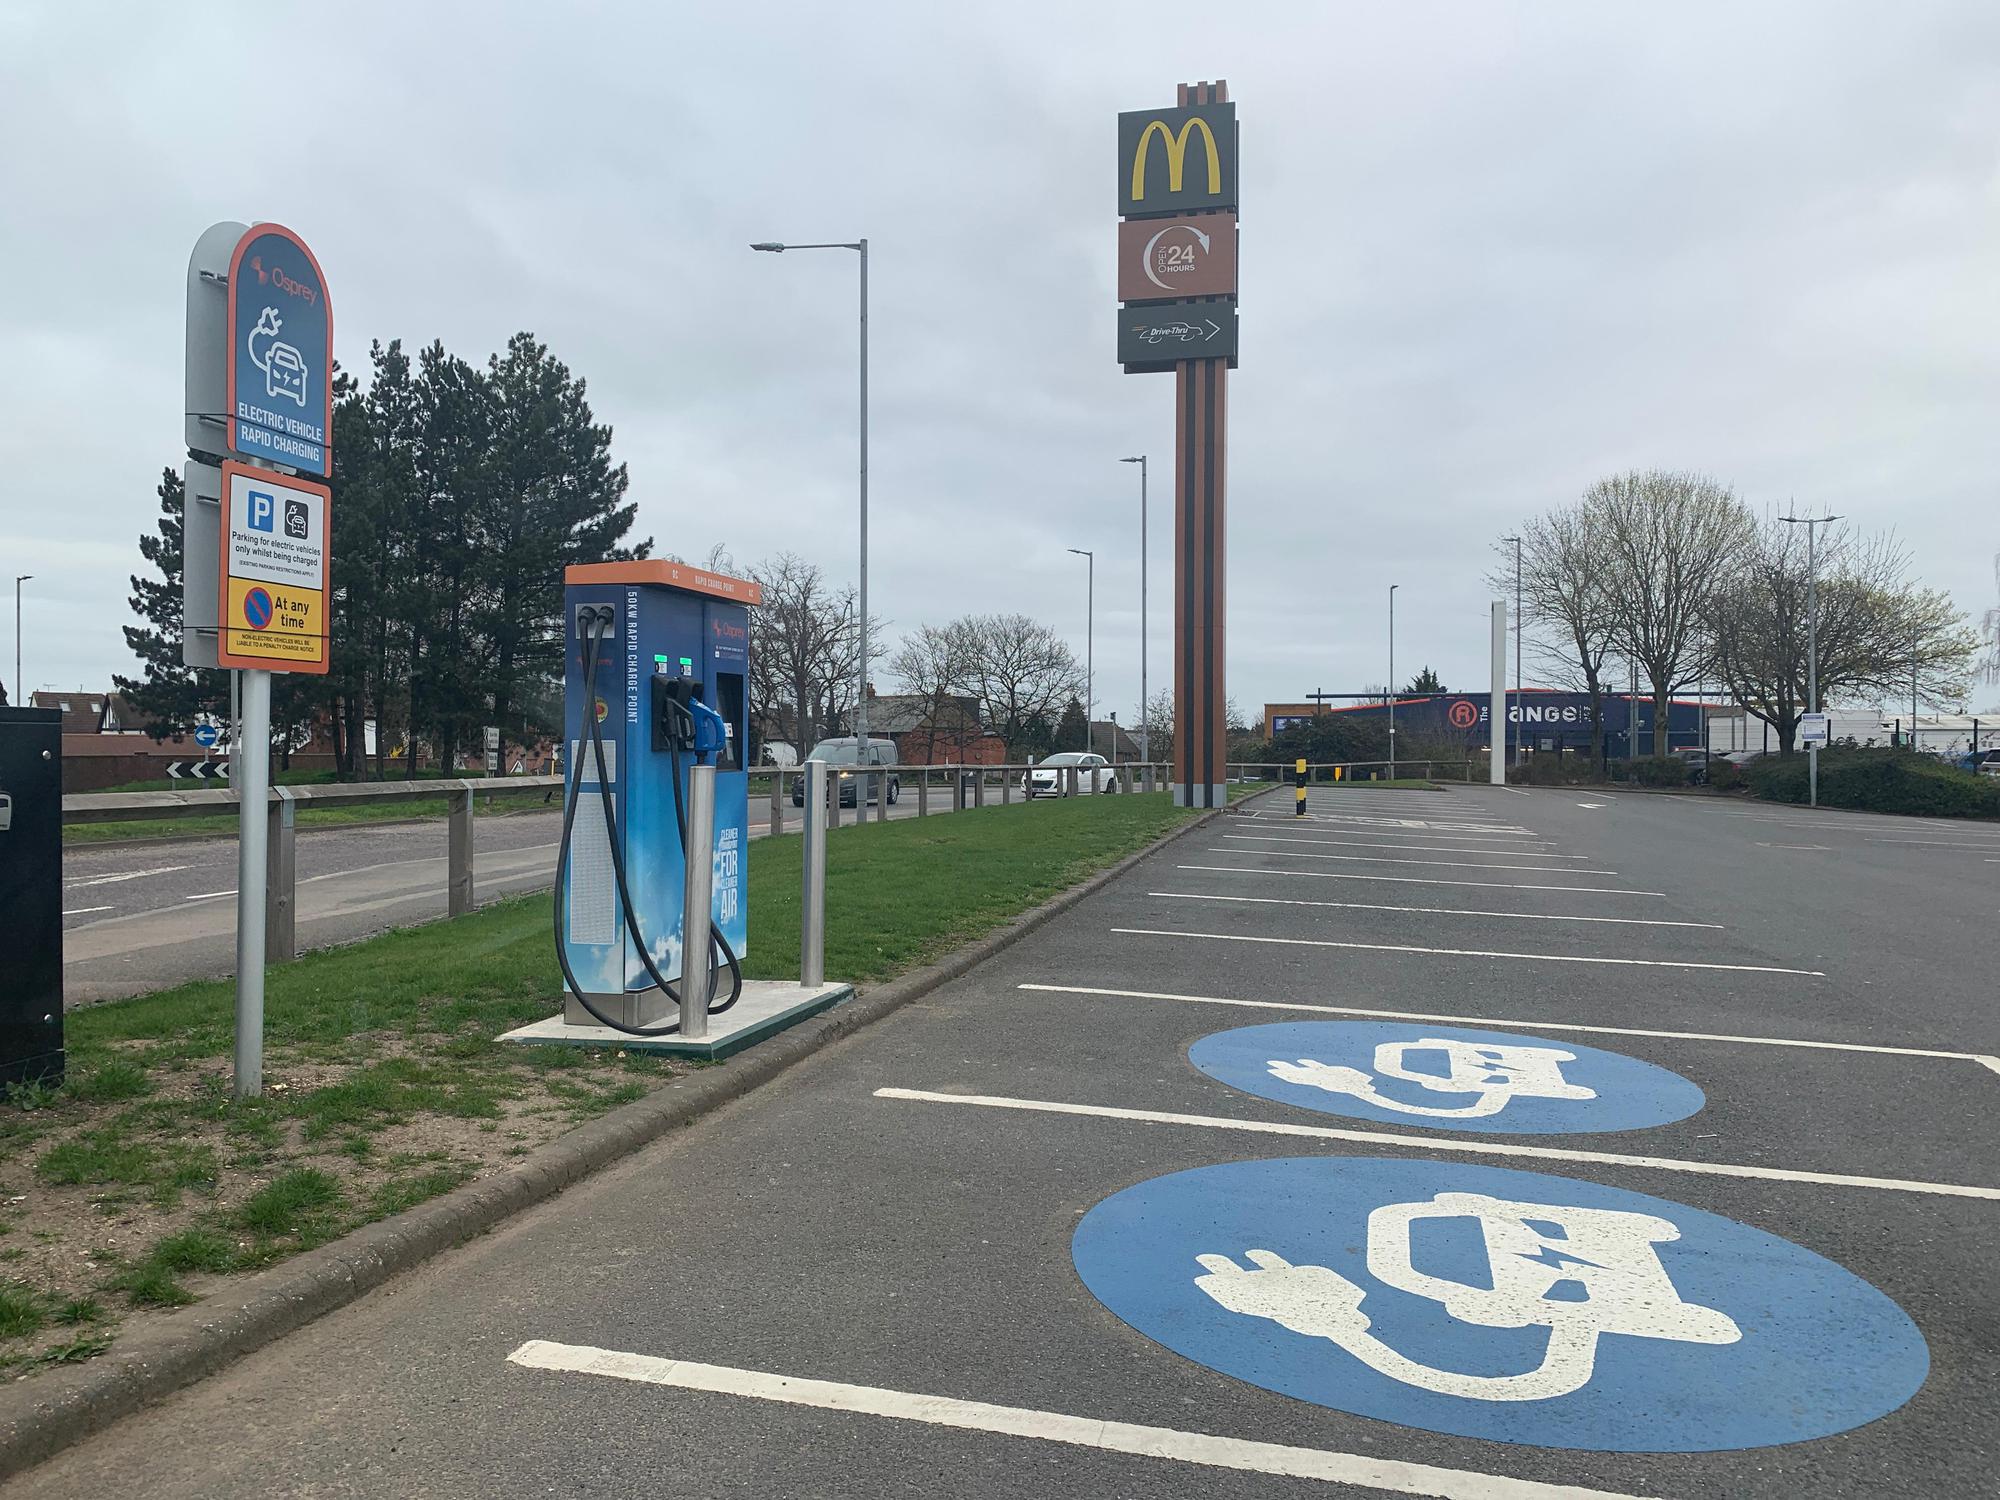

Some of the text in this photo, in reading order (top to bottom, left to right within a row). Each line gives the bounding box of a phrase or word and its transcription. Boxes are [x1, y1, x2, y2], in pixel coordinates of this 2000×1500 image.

[1158, 246, 1166, 273] OPEN
[1167, 245, 1195, 265] 24
[1167, 264, 1195, 273] HOURS
[272, 267, 317, 306] Osprey
[1150, 327, 1189, 336] Drive-Thru
[238, 401, 322, 442] ELECTRIC VEHICLE
[241, 425, 320, 462] RAPID CHARGING
[254, 496, 270, 527] P
[232, 531, 321, 556] Parking for electric vehicles
[235, 545, 318, 566] only whilst being charged
[258, 563, 276, 571] PARKING
[275, 596, 309, 615] At any
[281, 614, 304, 628] time
[242, 633, 273, 643] NON-ELECTRIC
[274, 637, 294, 645] VEHICLES
[263, 642, 282, 650] PENALTY
[628, 591, 638, 723] 50KW RAPID CHARGE POINT
[1480, 706, 1488, 722] The
[721, 850, 738, 878] FOR
[720, 887, 738, 920] AIR
